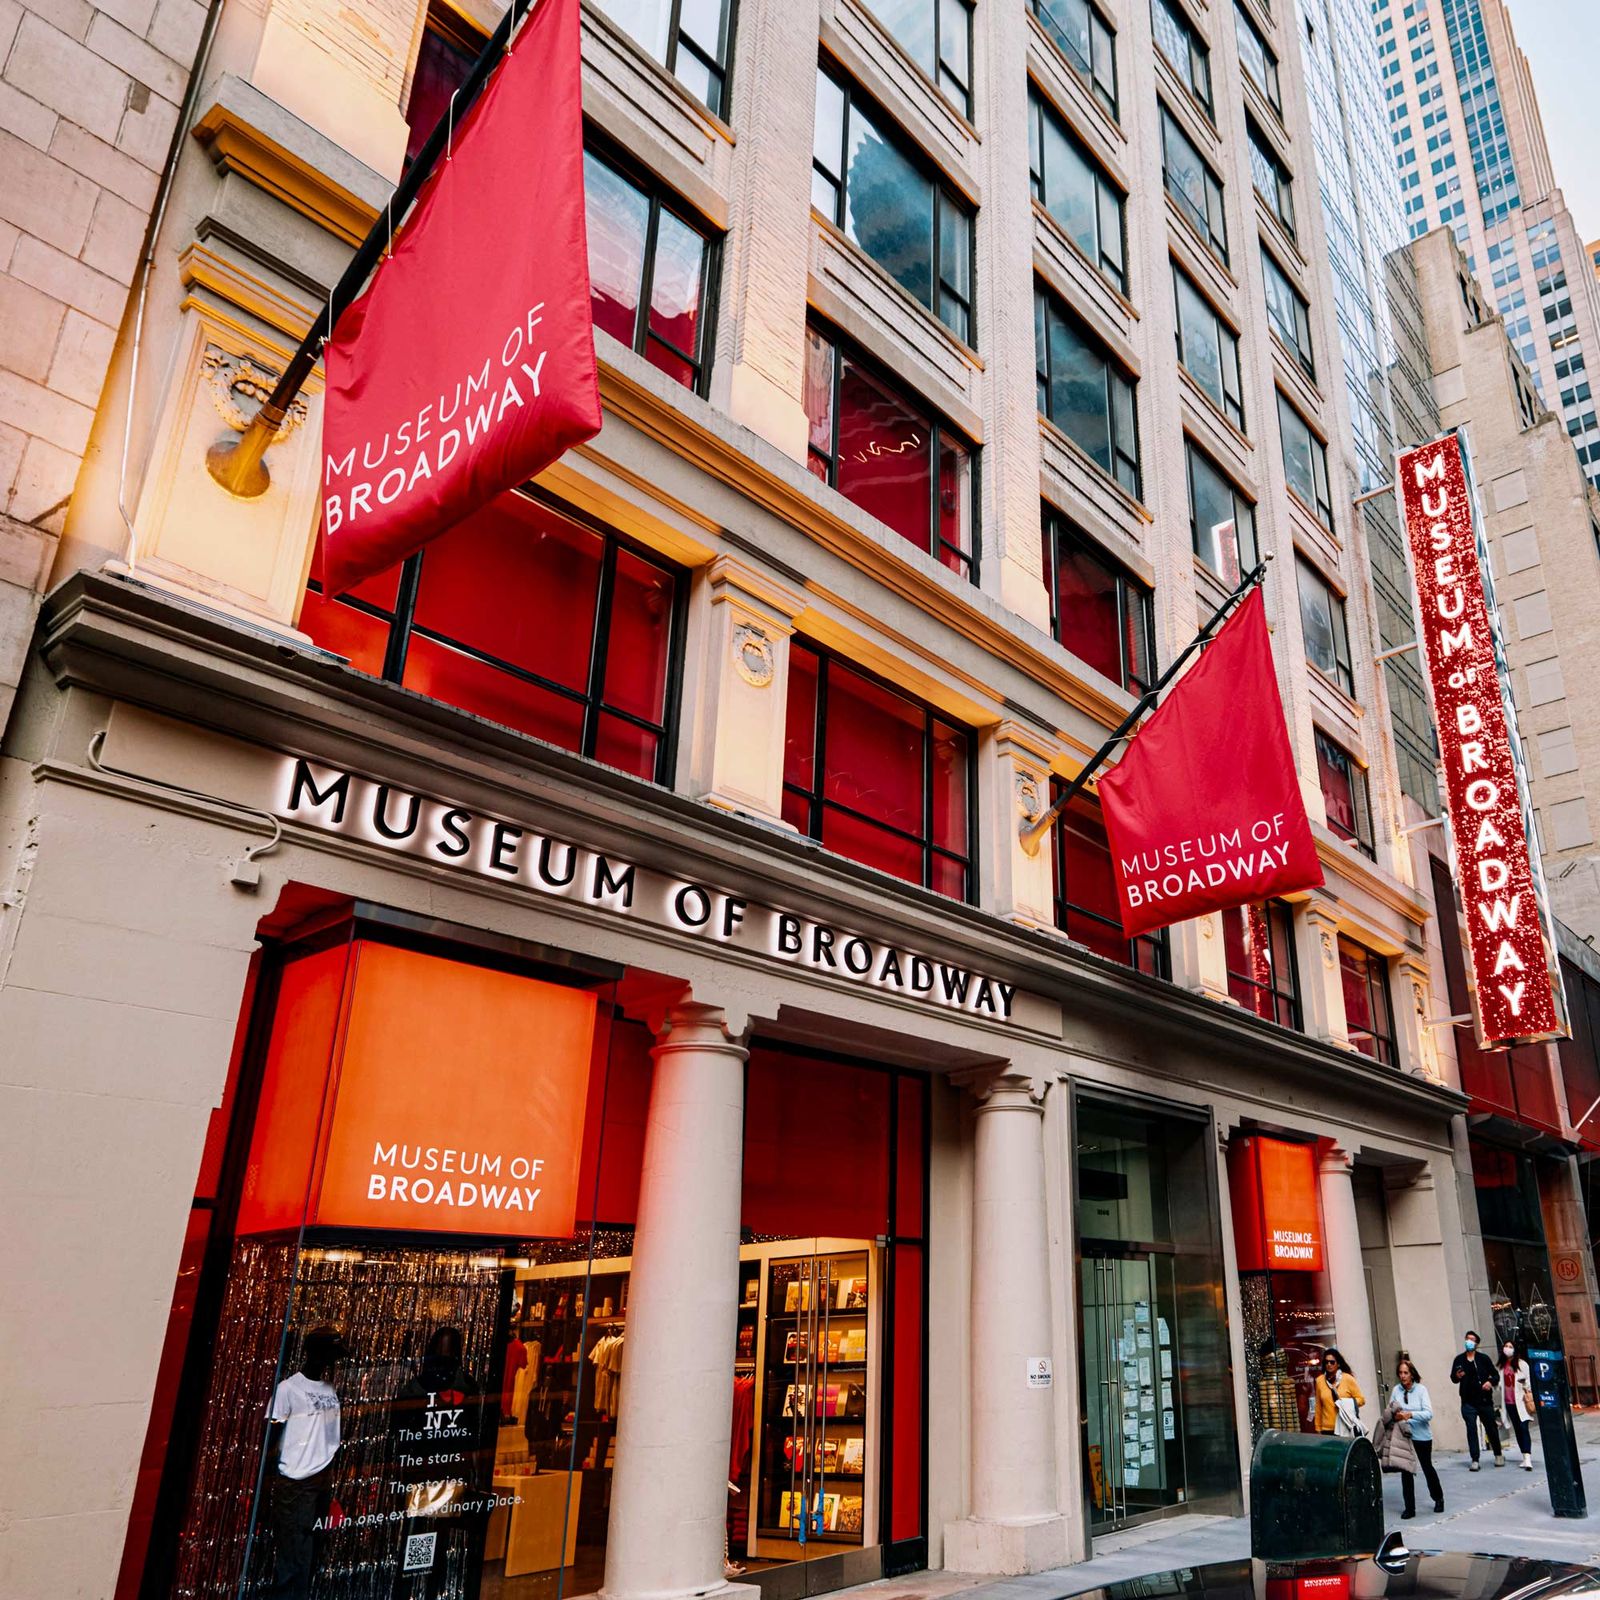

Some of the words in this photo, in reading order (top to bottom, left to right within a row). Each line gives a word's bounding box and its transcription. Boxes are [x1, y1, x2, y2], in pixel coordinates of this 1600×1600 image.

[326, 358, 490, 486] MUSEUM
[502, 302, 545, 367] OF
[326, 351, 547, 536] BROADWAY
[1414, 453, 1474, 657] MUSEUM
[1449, 668, 1477, 689] OF
[1121, 828, 1242, 879] MUSEUM
[1251, 812, 1284, 842] OF
[1456, 704, 1526, 1017] BROADWAY
[287, 759, 635, 908] MUSEUM
[675, 885, 747, 937] OF
[778, 914, 1017, 1018] BROADWAY
[1126, 841, 1289, 908] BROADWAY
[373, 1142, 502, 1177] MUSEUM
[510, 1157, 544, 1181] OF
[367, 1174, 541, 1212] BROADWAY
[1273, 1230, 1302, 1243] MUSEUM
[1303, 1232, 1312, 1244] OF
[1274, 1244, 1313, 1259] BROADWAY
[1539, 1362, 1549, 1378] P
[427, 1392, 437, 1408] I
[399, 1429, 422, 1441] The
[427, 1427, 472, 1439] shows.
[423, 1409, 464, 1430] NY
[399, 1454, 423, 1467] The
[427, 1452, 465, 1465] stars.
[389, 1481, 413, 1494] The
[418, 1476, 468, 1491] stories.
[312, 1517, 333, 1532] All
[338, 1515, 352, 1528] in
[357, 1513, 384, 1526] one
[487, 1495, 525, 1512] place.
